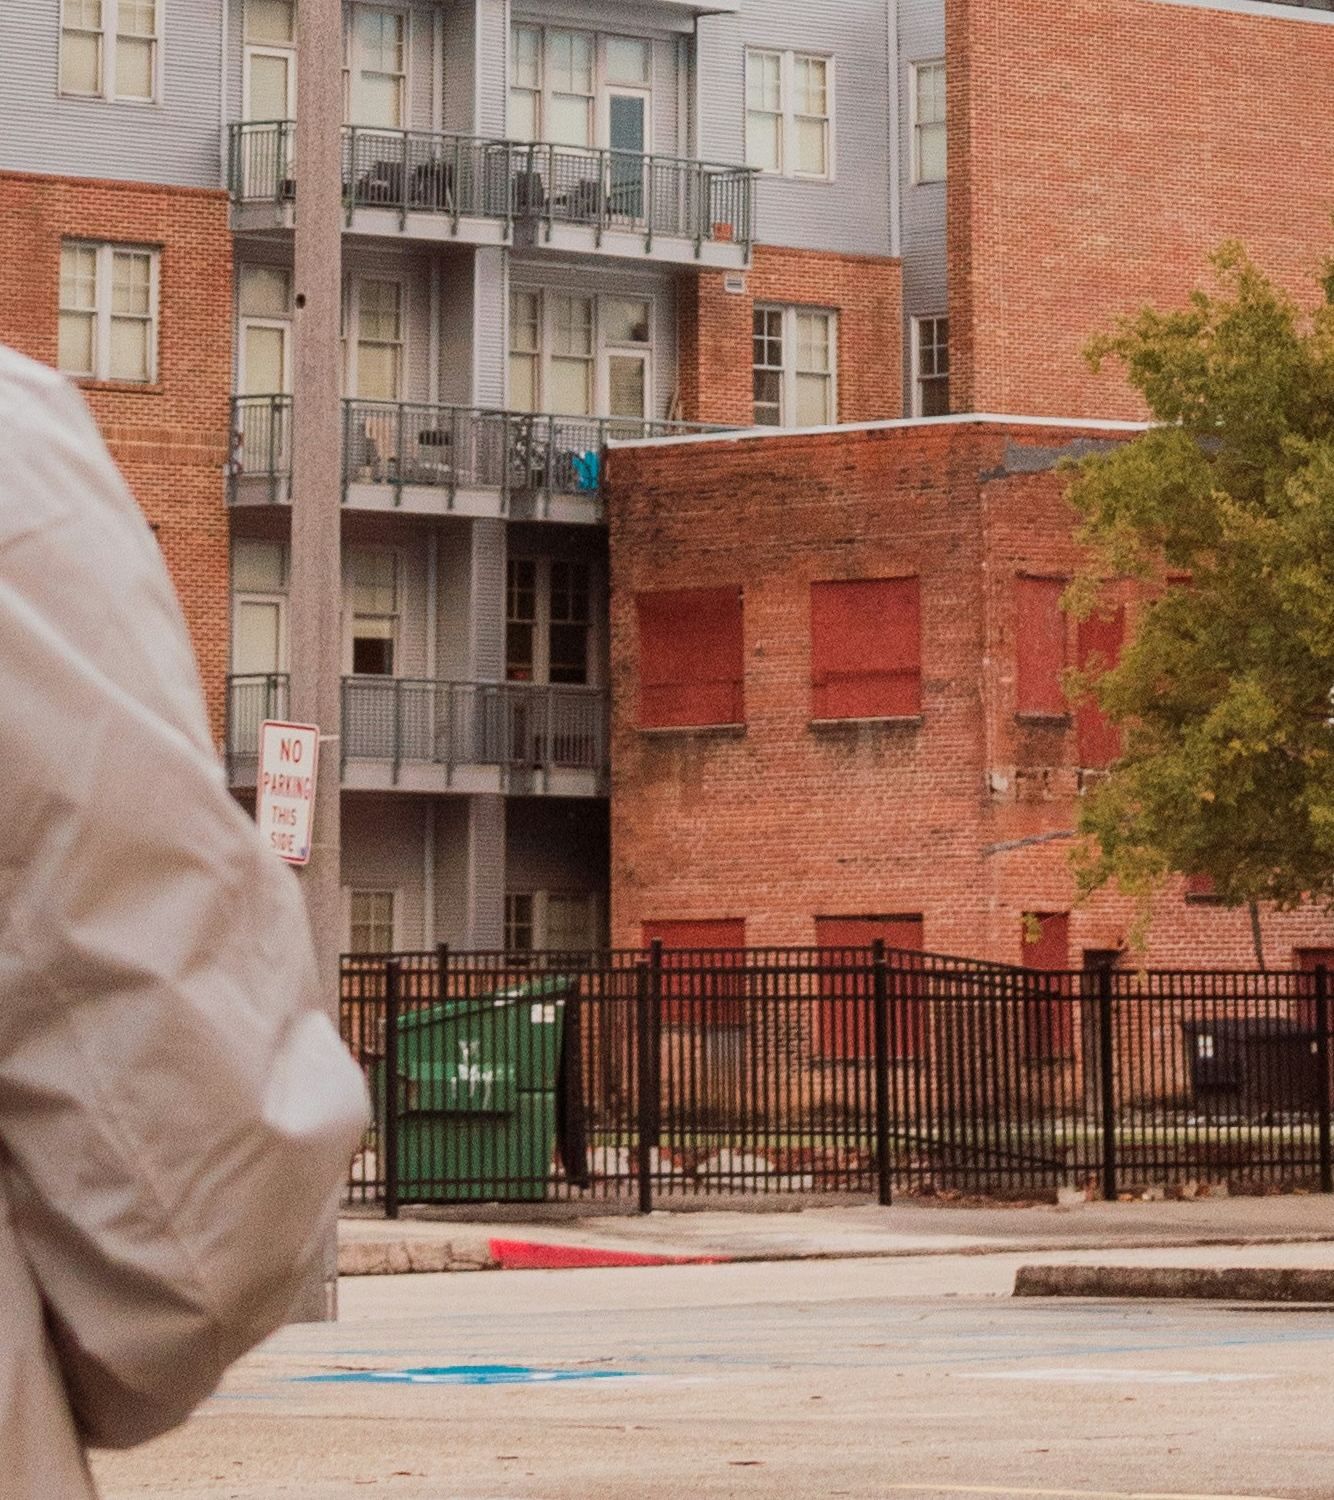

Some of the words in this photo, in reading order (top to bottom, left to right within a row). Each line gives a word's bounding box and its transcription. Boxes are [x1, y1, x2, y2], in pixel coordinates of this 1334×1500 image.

[279, 738, 303, 764] NO
[263, 771, 313, 800] PARKING
[272, 805, 297, 827] THIS
[270, 831, 296, 852] SIDE
